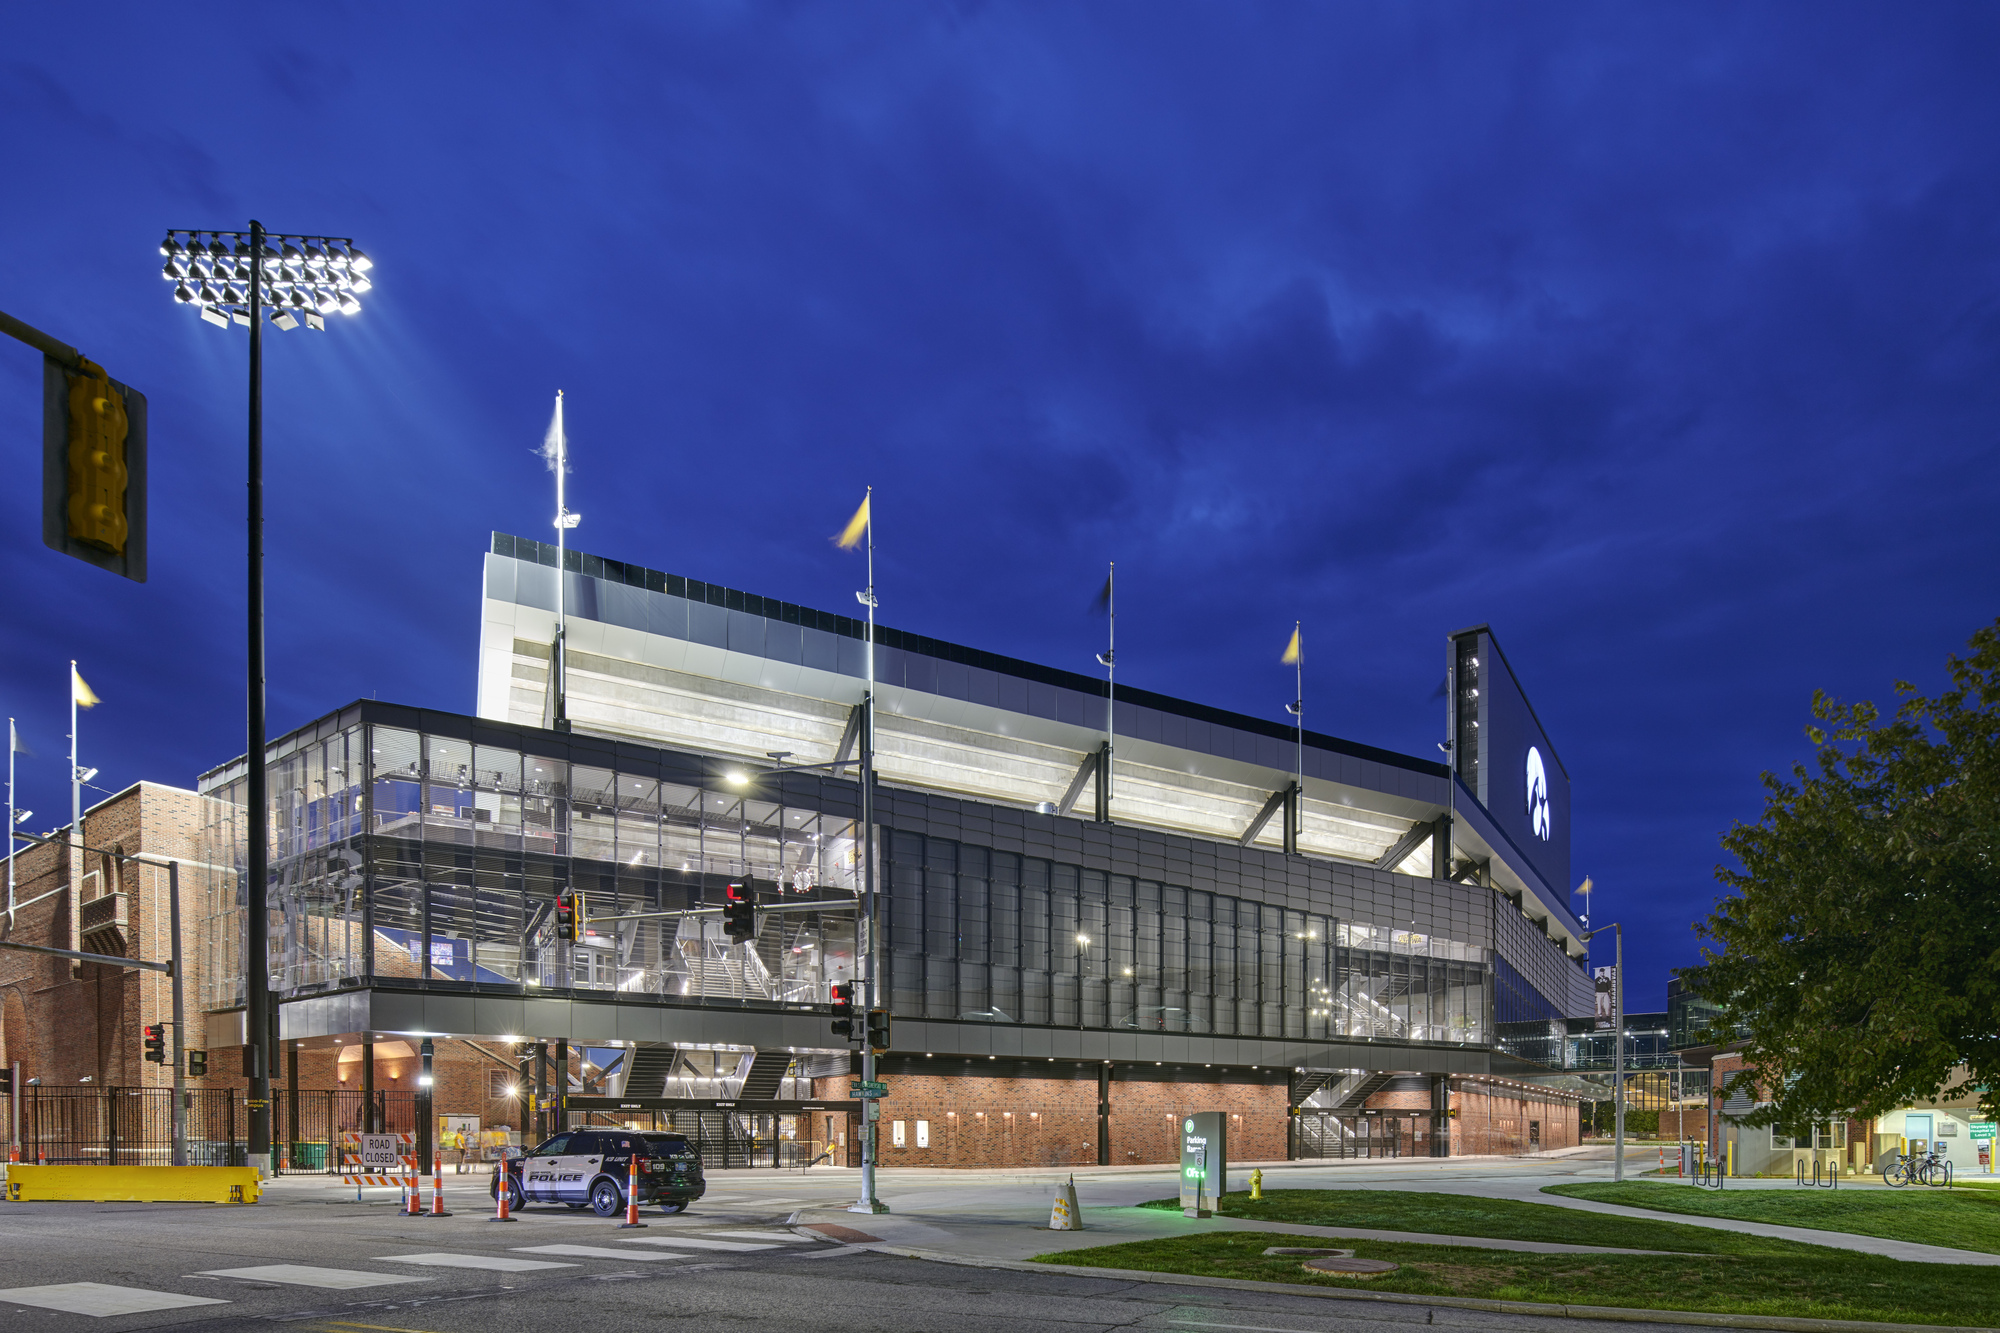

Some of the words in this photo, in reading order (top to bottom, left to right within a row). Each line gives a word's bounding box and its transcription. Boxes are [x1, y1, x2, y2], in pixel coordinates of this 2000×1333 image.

[369, 1139, 390, 1149] ROAD
[1187, 1136, 1206, 1145] Parking
[365, 1153, 395, 1163] CLOSED
[528, 1174, 584, 1182] POLICE
